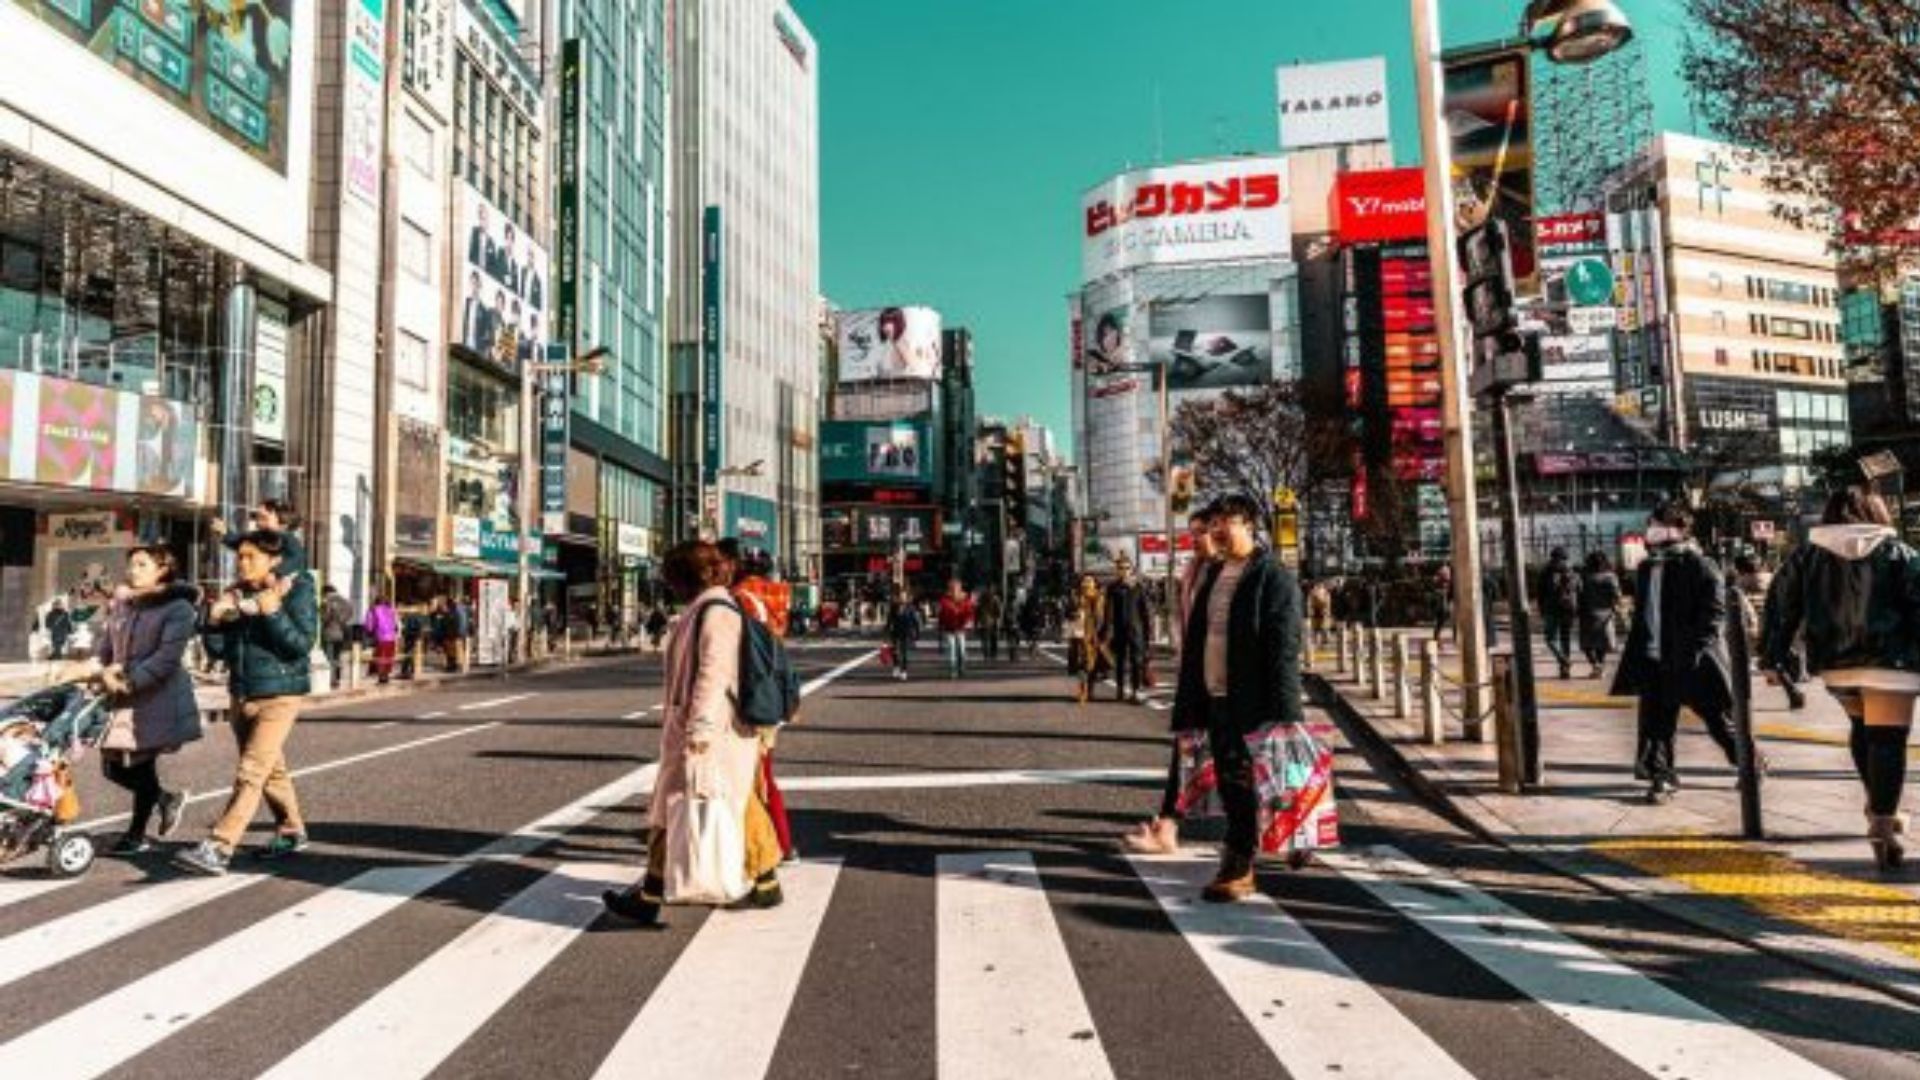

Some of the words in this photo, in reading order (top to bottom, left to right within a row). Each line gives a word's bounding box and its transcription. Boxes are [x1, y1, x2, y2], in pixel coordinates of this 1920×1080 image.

[1280, 91, 1382, 114] TAKANO
[1087, 174, 1279, 236] ビックカメラ
[1346, 196, 1425, 216] Y!mobi
[1143, 219, 1251, 247] CAMERA
[1699, 409, 1746, 429] LUSH
